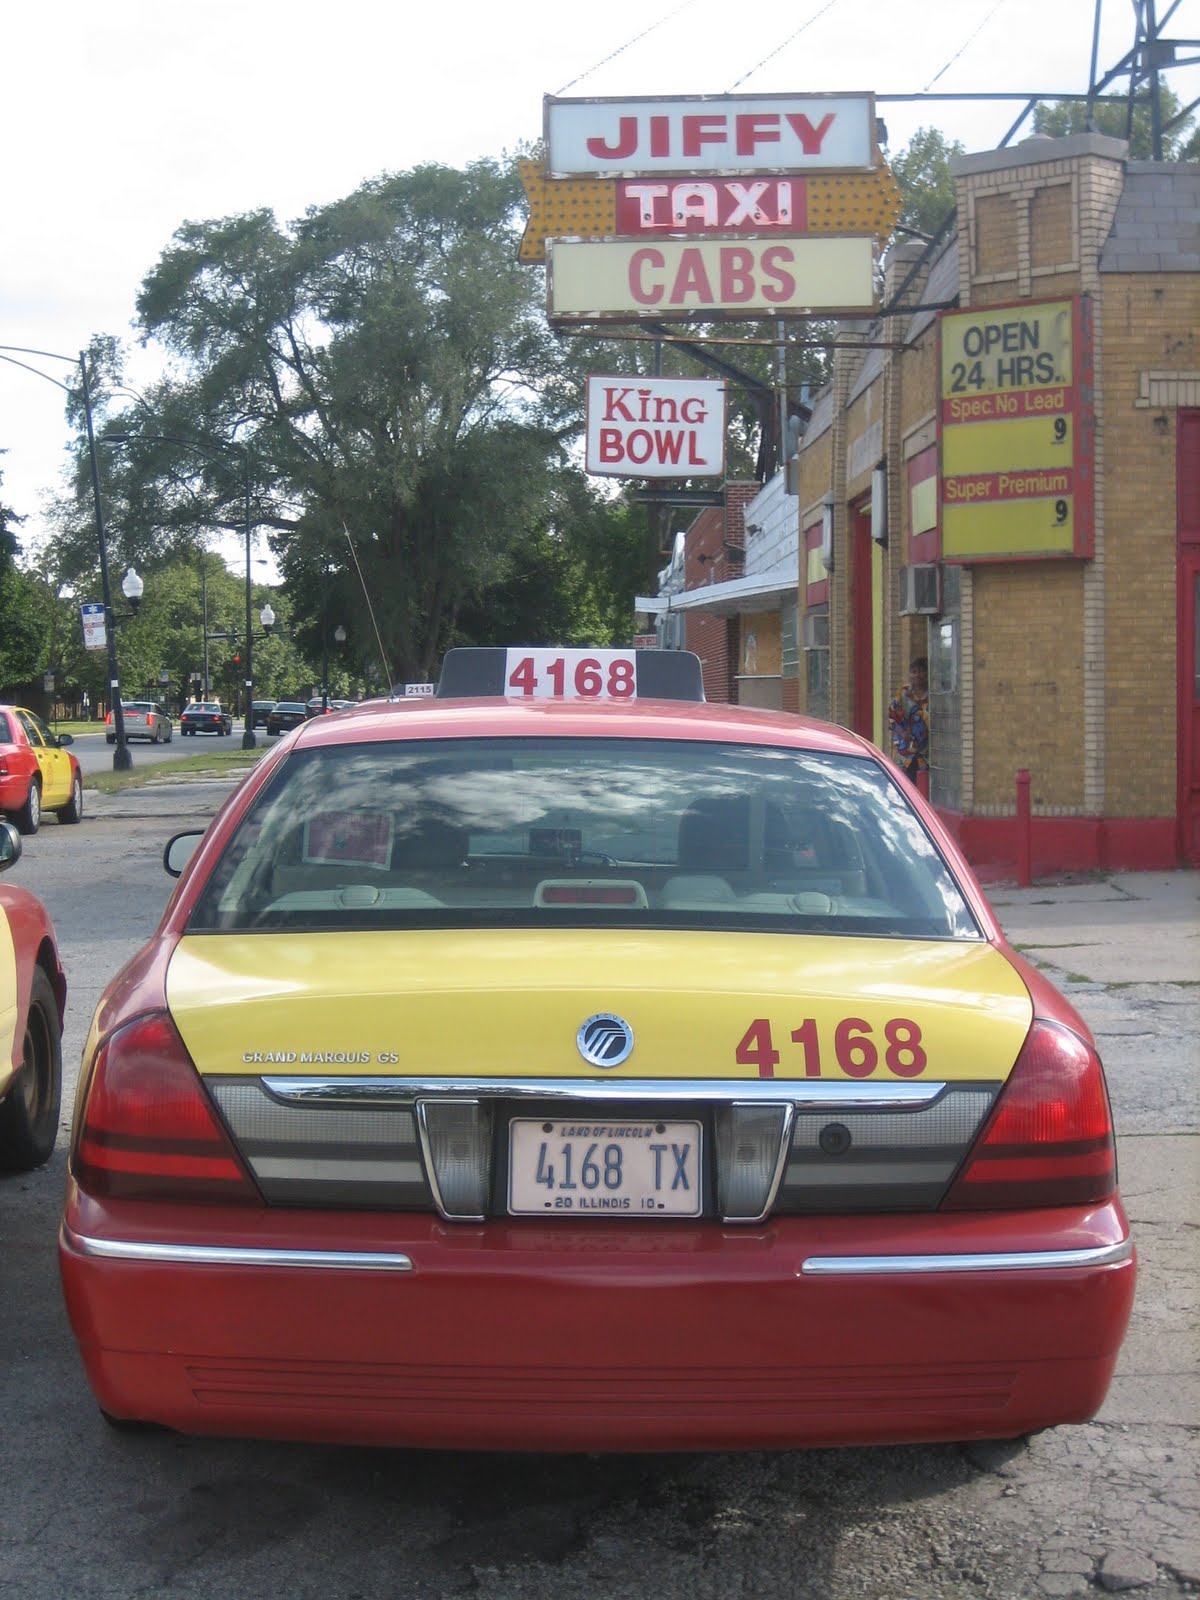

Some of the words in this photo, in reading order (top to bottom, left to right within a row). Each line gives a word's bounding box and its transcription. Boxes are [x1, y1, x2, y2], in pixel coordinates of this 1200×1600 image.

[586, 113, 836, 159] JIFFY
[625, 182, 792, 227] TAXI
[628, 246, 796, 305] CABS
[963, 320, 1040, 357] OPEN
[951, 361, 985, 393] 24
[997, 352, 1061, 388] HRS.
[996, 395, 1018, 414] No
[1025, 389, 1065, 411] Lead
[600, 428, 708, 465] BOWL
[1054, 418, 1067, 441] 9
[946, 479, 992, 501] Super
[998, 472, 1068, 495] Premium
[1055, 499, 1068, 522] 9
[407, 685, 432, 694] 2115
[509, 657, 636, 697] 4168
[242, 1052, 296, 1063] GRAND
[300, 1052, 370, 1063] MARQUIS
[377, 1052, 399, 1063] GS
[735, 1017, 928, 1078] 4168
[560, 1126, 590, 1137] LAND
[593, 1126, 606, 1137] OF
[608, 1127, 653, 1137] LINCOLN
[536, 1142, 623, 1189] 4168
[649, 1143, 690, 1190] TX
[555, 1197, 573, 1208] 20
[579, 1197, 631, 1209] ILLINOIS
[641, 1198, 655, 1209] 10
